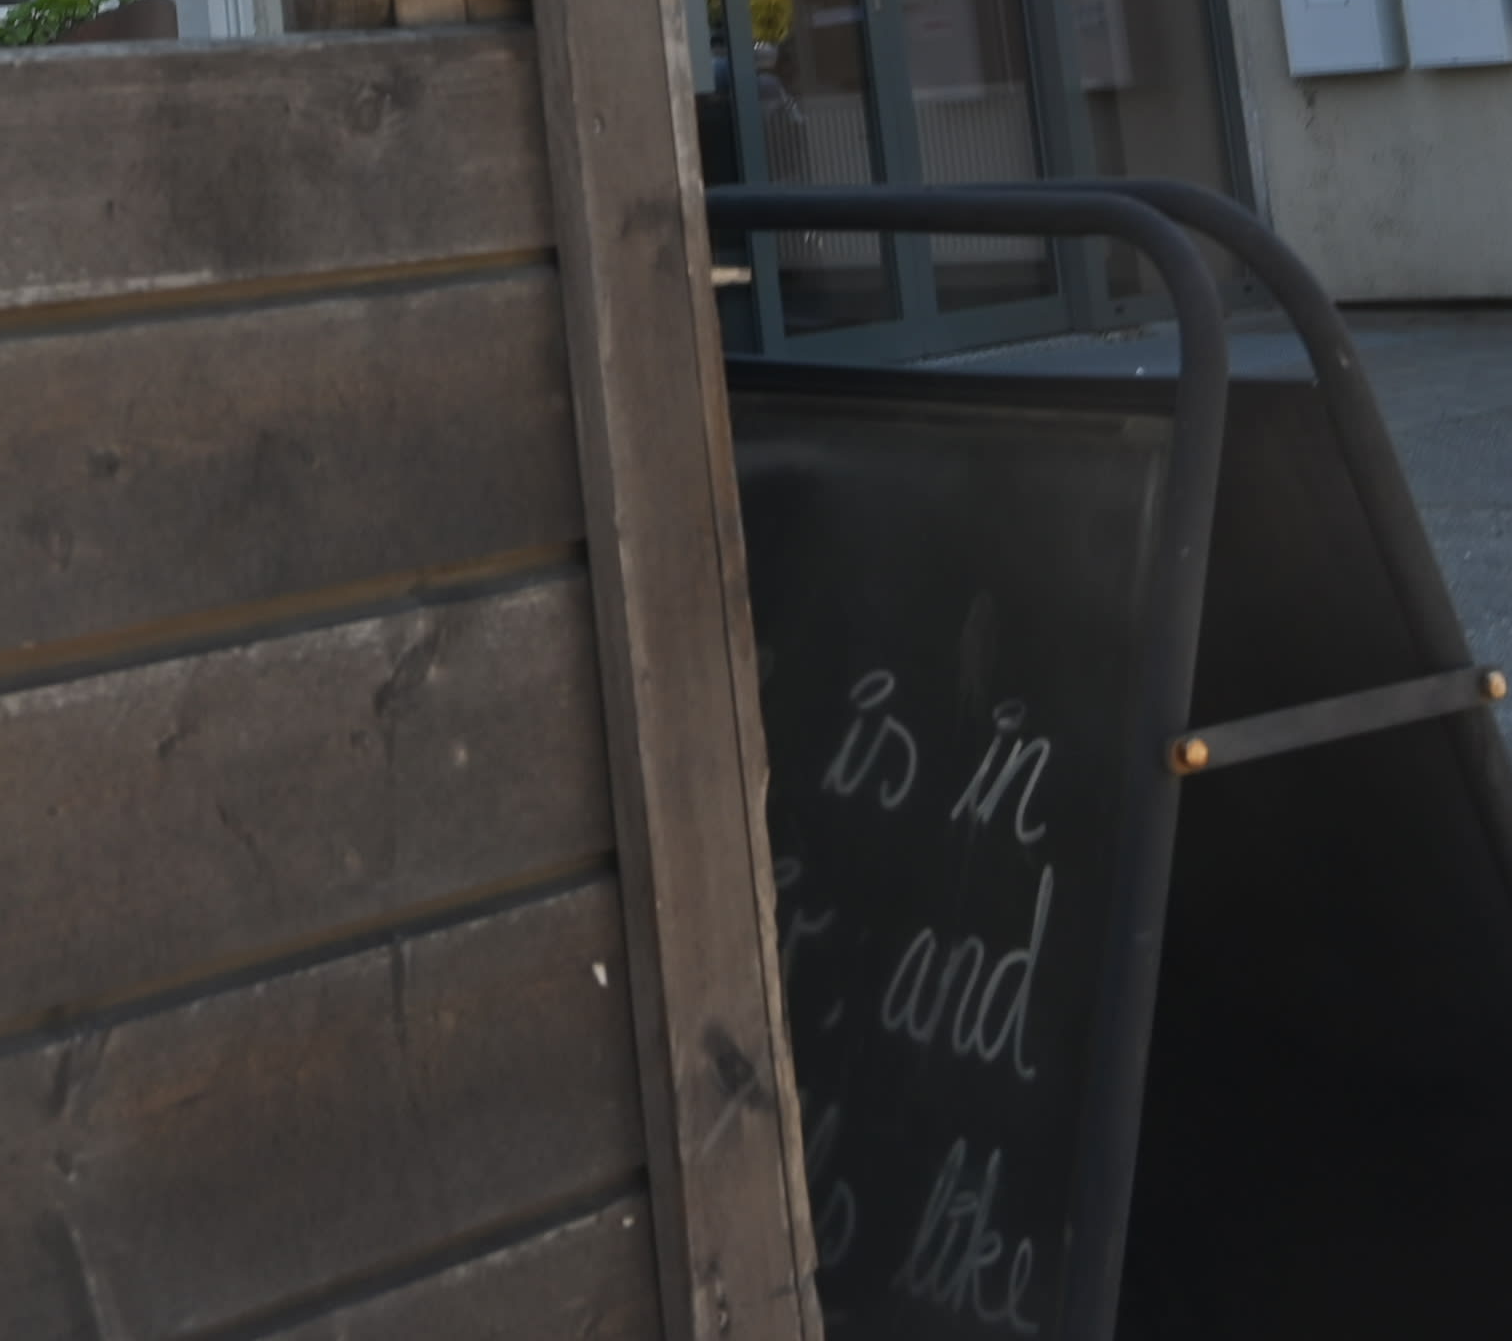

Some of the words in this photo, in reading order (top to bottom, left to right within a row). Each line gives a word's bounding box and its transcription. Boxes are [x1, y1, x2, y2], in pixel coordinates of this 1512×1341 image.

[821, 670, 918, 808] is
[951, 701, 1051, 843] in
[882, 863, 1054, 1080] and
